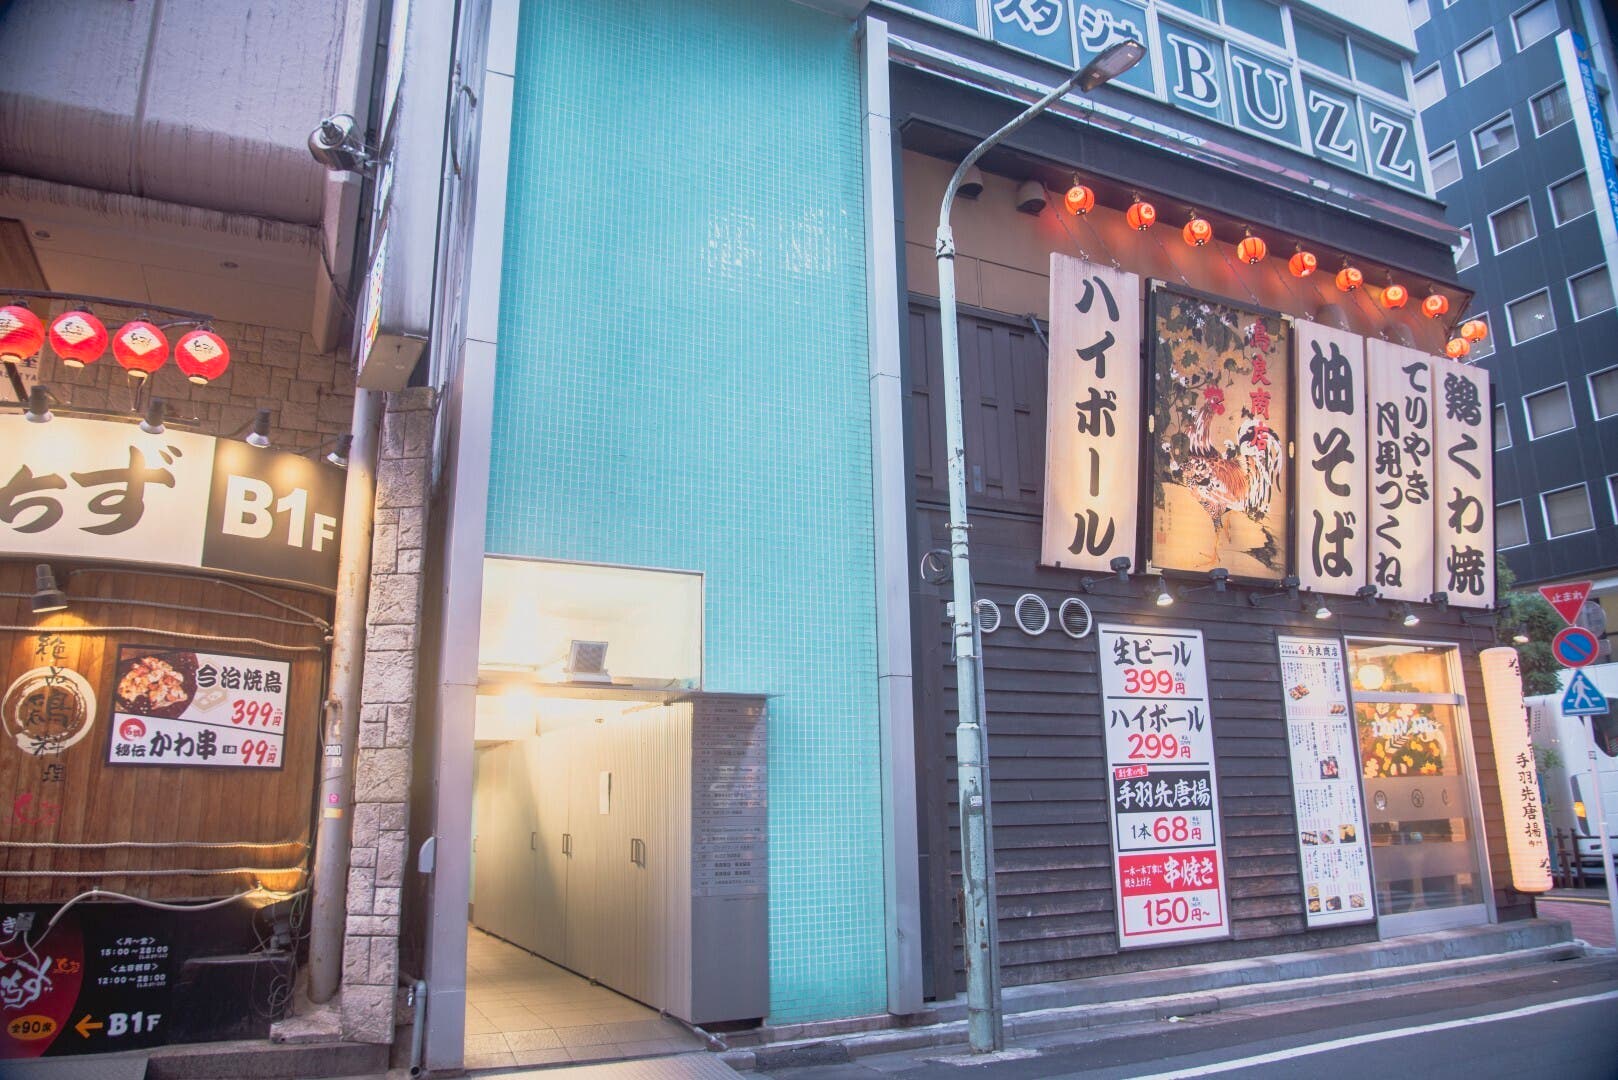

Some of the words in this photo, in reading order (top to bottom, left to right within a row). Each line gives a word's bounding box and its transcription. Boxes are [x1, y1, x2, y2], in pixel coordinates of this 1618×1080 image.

[1166, 34, 1416, 182] BUZZ
[1067, 275, 1120, 557] ハイボール
[1249, 318, 1272, 451] 鳥良商店
[1310, 339, 1356, 578] 油そば
[1402, 361, 1430, 504] てりやき
[222, 475, 337, 552] B1F
[1375, 402, 1402, 587] 月見つくね
[1552, 590, 1584, 603] 止まれ
[197, 664, 283, 693] 今治焼鳥
[1113, 636, 1192, 667] 生ビール
[1111, 703, 1205, 733] ハイボール
[1116, 779, 1211, 809] 手羽先唐揚
[1515, 752, 1542, 837] 手羽先唐揚
[1163, 855, 1214, 889] 串焼き
[107, 1011, 162, 1037] B1F
